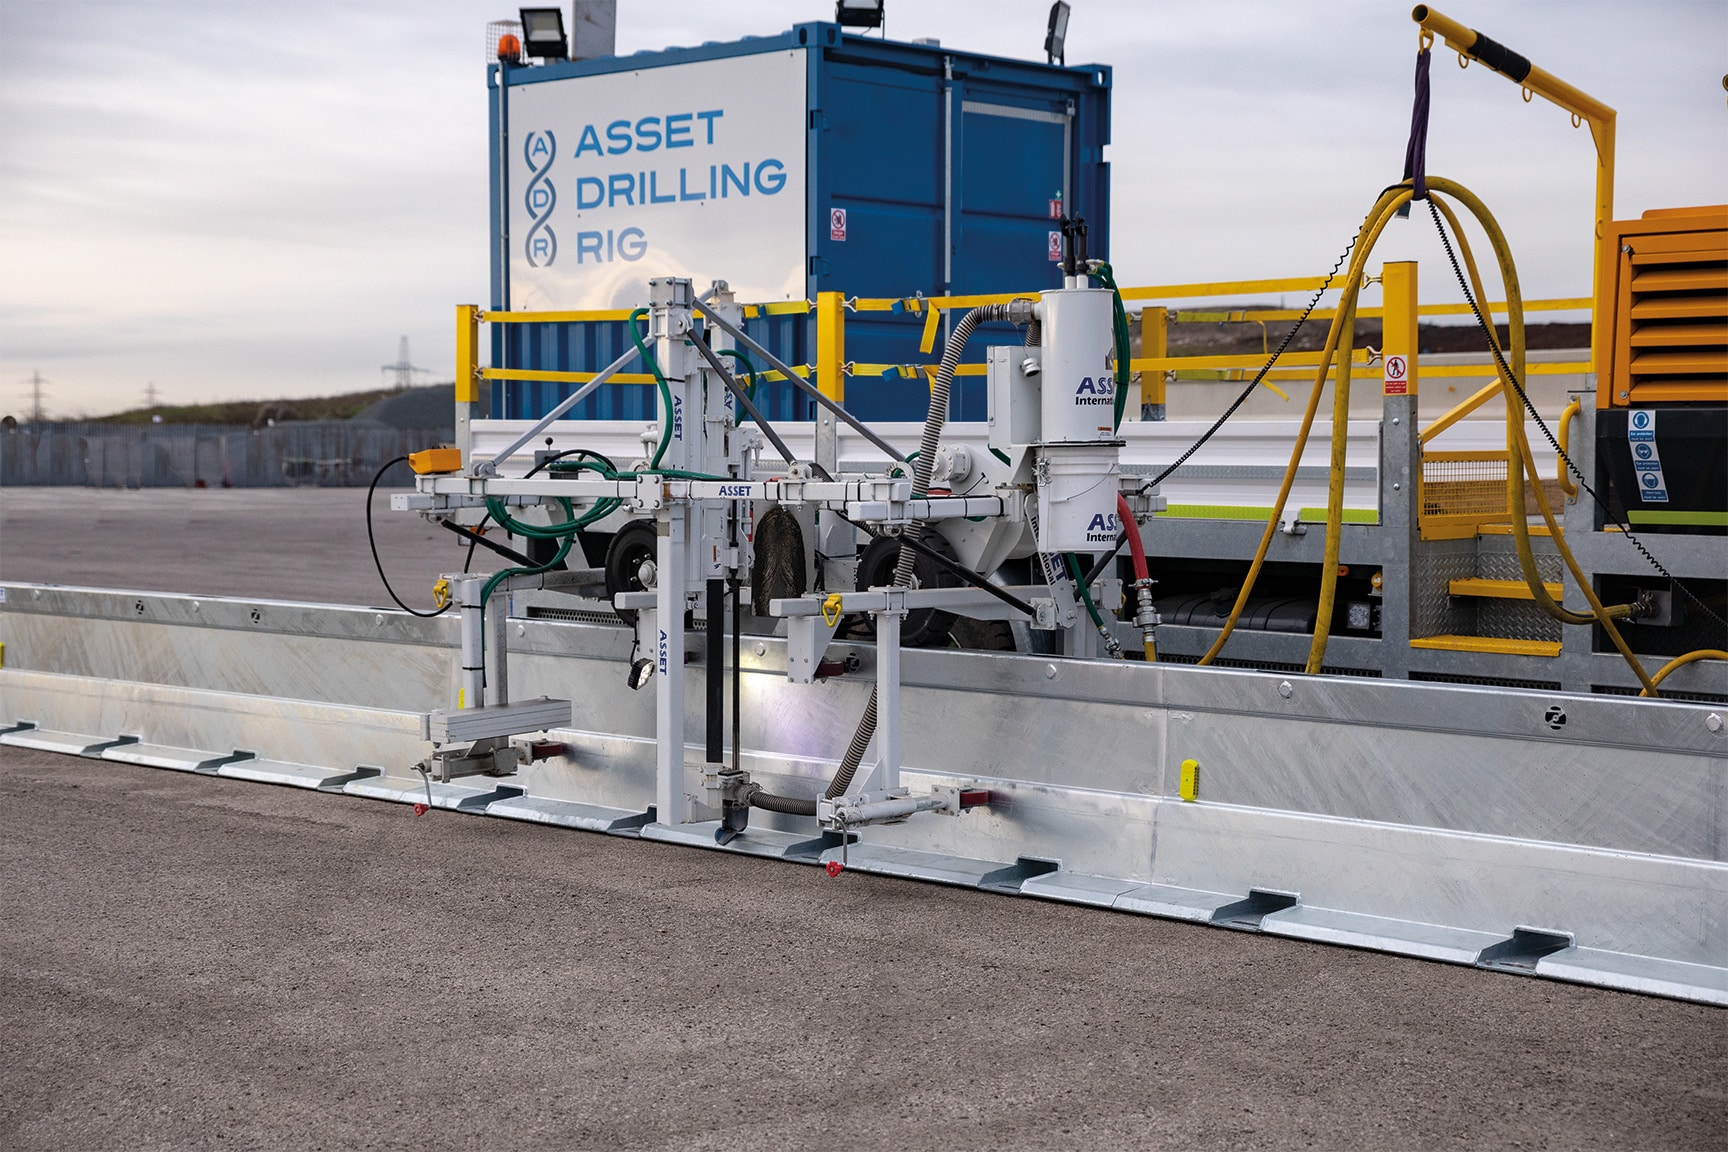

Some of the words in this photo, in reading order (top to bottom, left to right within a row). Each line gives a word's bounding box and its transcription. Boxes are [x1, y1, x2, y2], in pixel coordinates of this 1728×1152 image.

[574, 109, 723, 158] ASSET
[577, 158, 787, 210] DRILLING
[577, 227, 648, 265] RIG
[674, 394, 682, 441] ASSET
[718, 485, 751, 497] ASSET
[1086, 513, 1117, 531] AS
[659, 629, 667, 676] ASSET
